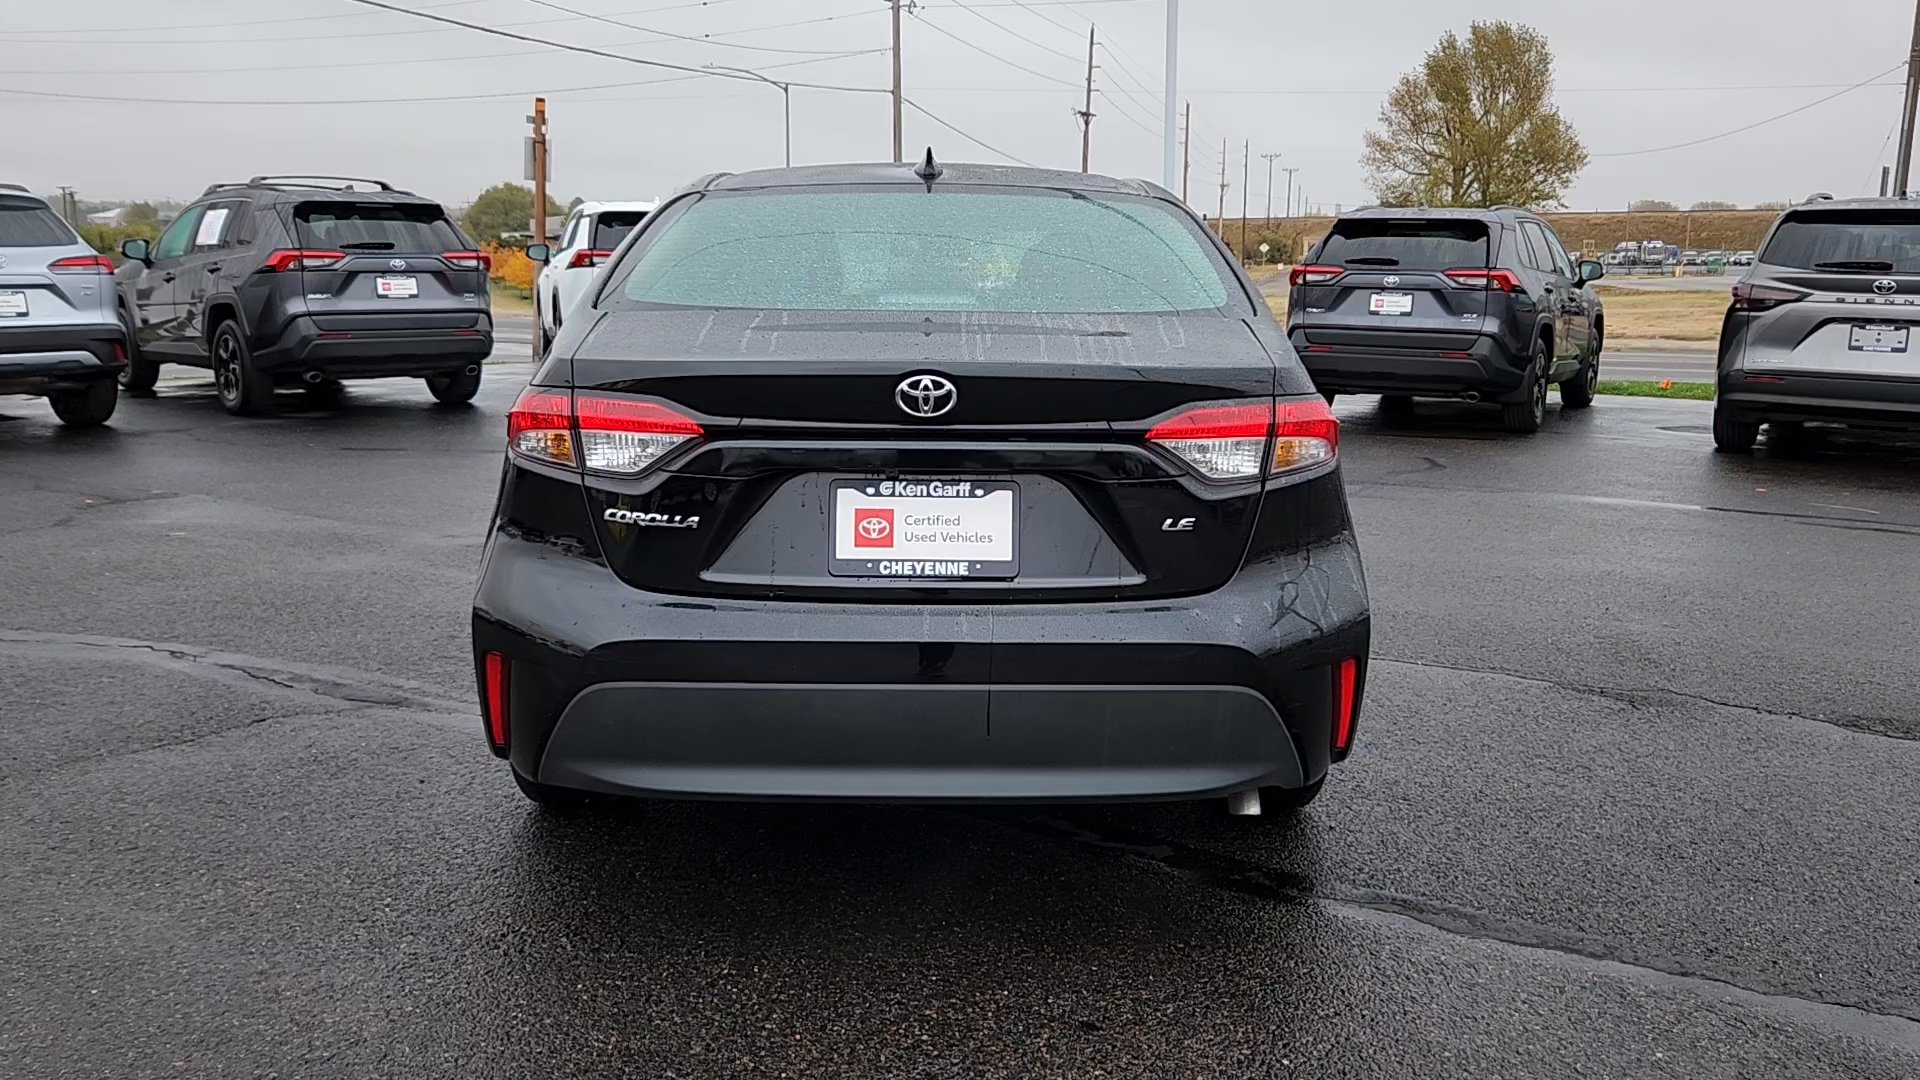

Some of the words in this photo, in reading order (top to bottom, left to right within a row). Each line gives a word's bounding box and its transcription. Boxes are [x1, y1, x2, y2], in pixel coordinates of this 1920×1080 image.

[603, 508, 700, 528] COROLLA
[904, 515, 960, 526] Certified
[1161, 517, 1196, 531] LE
[904, 531, 937, 543] Used
[940, 531, 993, 543] Vehicles
[879, 561, 969, 576] CHEYENNE
